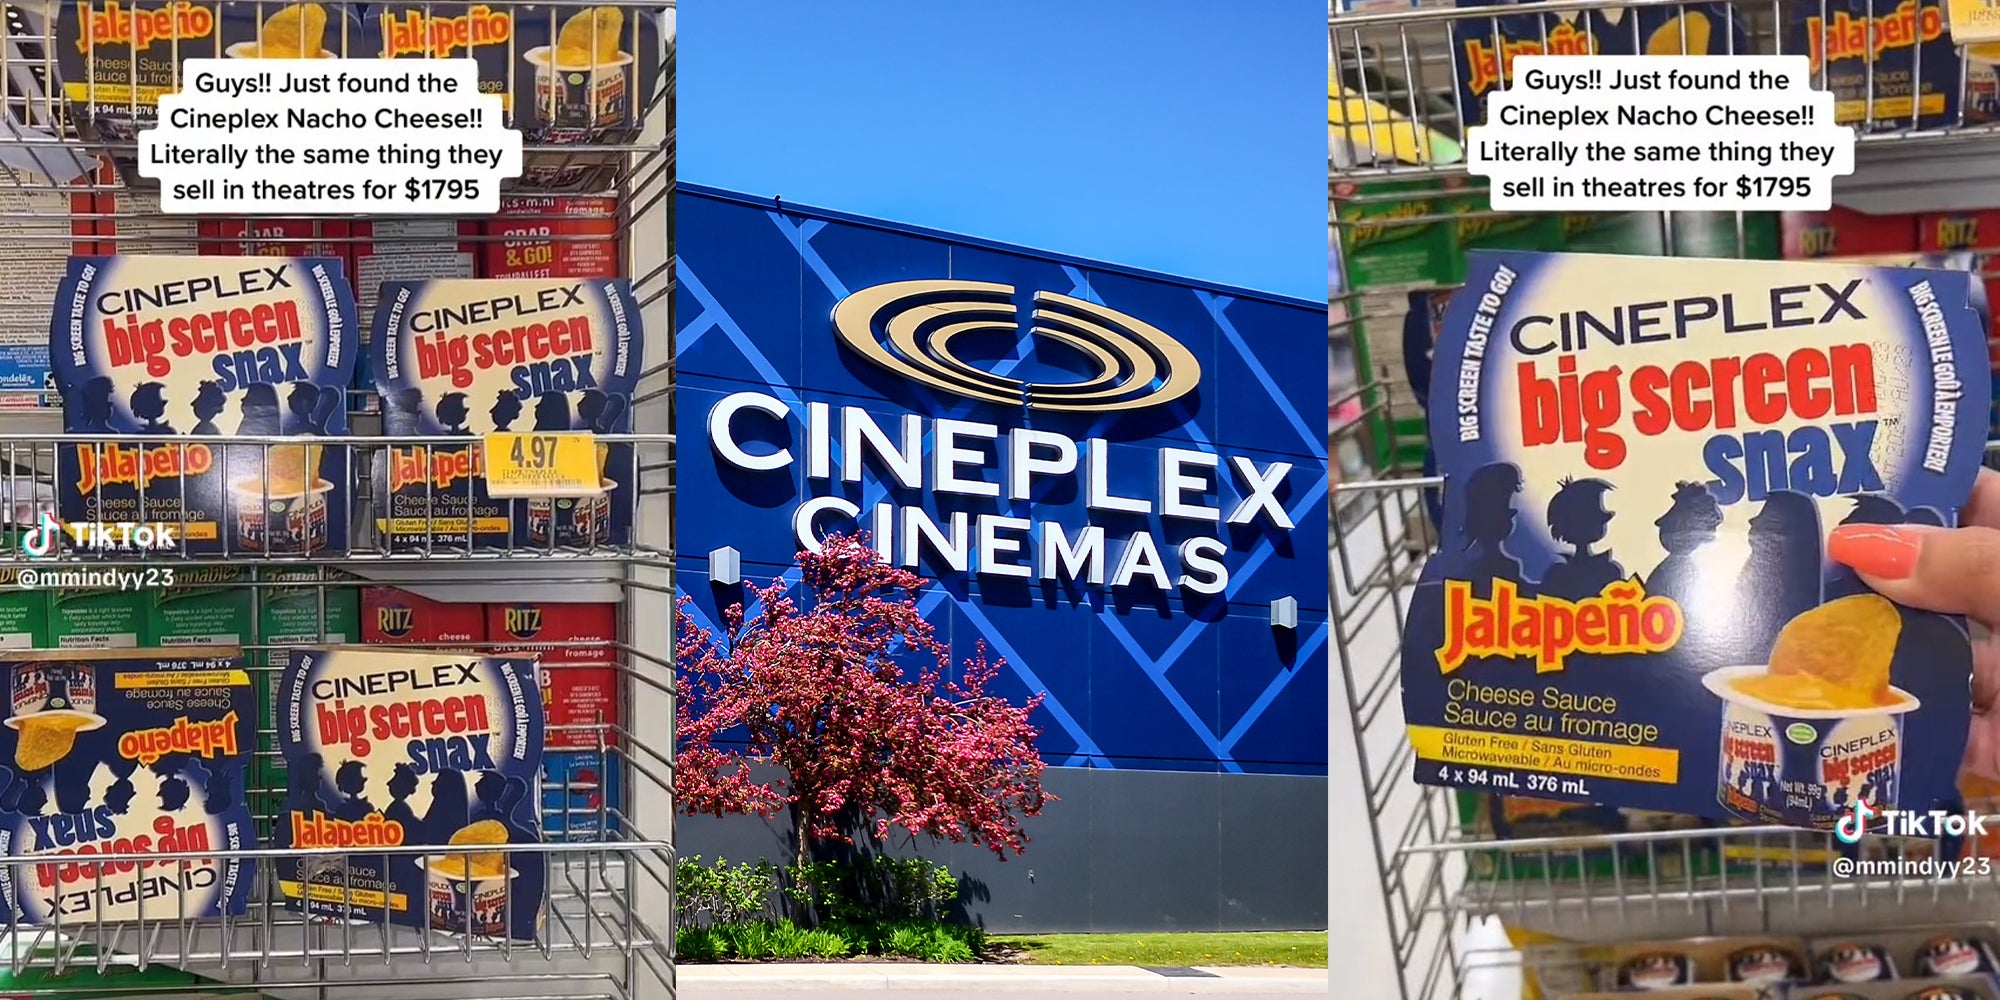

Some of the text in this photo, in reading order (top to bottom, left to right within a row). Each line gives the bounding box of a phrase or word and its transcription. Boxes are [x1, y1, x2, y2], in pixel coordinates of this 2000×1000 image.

[1937, 217, 1979, 247] RITZ
[505, 249, 522, 267] &
[524, 245, 553, 265] GO!
[96, 264, 291, 315] CINEPLEX
[410, 283, 585, 333] CINEPLEX
[1510, 278, 1867, 355] CINEPLEX
[1908, 280, 1936, 313] BIG
[1922, 301, 1951, 348] SCREEN
[103, 314, 171, 377] big
[168, 300, 301, 357] screen
[415, 315, 592, 388] big screen
[1458, 264, 1517, 442] BIG SCREEN TASTE TO GO!
[213, 342, 308, 392] snax
[510, 353, 598, 400] snax
[1517, 354, 1627, 470] big
[1629, 342, 1878, 436] screen
[510, 436, 558, 468] 4.97
[707, 391, 1295, 530] CINEPLEX
[1702, 420, 1885, 506] snax
[792, 495, 1231, 594] CINEMAS
[377, 607, 414, 632] RITZ
[504, 607, 542, 633] RITZ
[1437, 575, 1682, 673] Jalapeño
[565, 649, 605, 659] fromage
[125, 688, 173, 699] fromage
[194, 687, 231, 698] Sauce
[311, 661, 481, 700] CINEPLEX
[1447, 678, 1617, 714] Cheese Sauce
[147, 698, 231, 710] Cheese Sauce
[1444, 703, 1658, 744] Sauce au fromage
[118, 710, 239, 768] Jalapeño
[316, 694, 489, 757] big screen
[1443, 732, 1485, 748] Gluten
[1490, 737, 1518, 750] Free
[1531, 741, 1564, 755] Sans
[1568, 744, 1612, 760] Gluten
[1820, 727, 1896, 758] CINEPLEX
[407, 733, 496, 775] snax
[1442, 746, 1540, 767] Microwaveable
[1553, 757, 1571, 769] Au
[1575, 760, 1661, 778] micro-ondes
[1438, 765, 1590, 795] 4 x 94 mL 376 mL
[290, 808, 404, 848] Jalapeño
[43, 867, 217, 917] CINEPLEX
